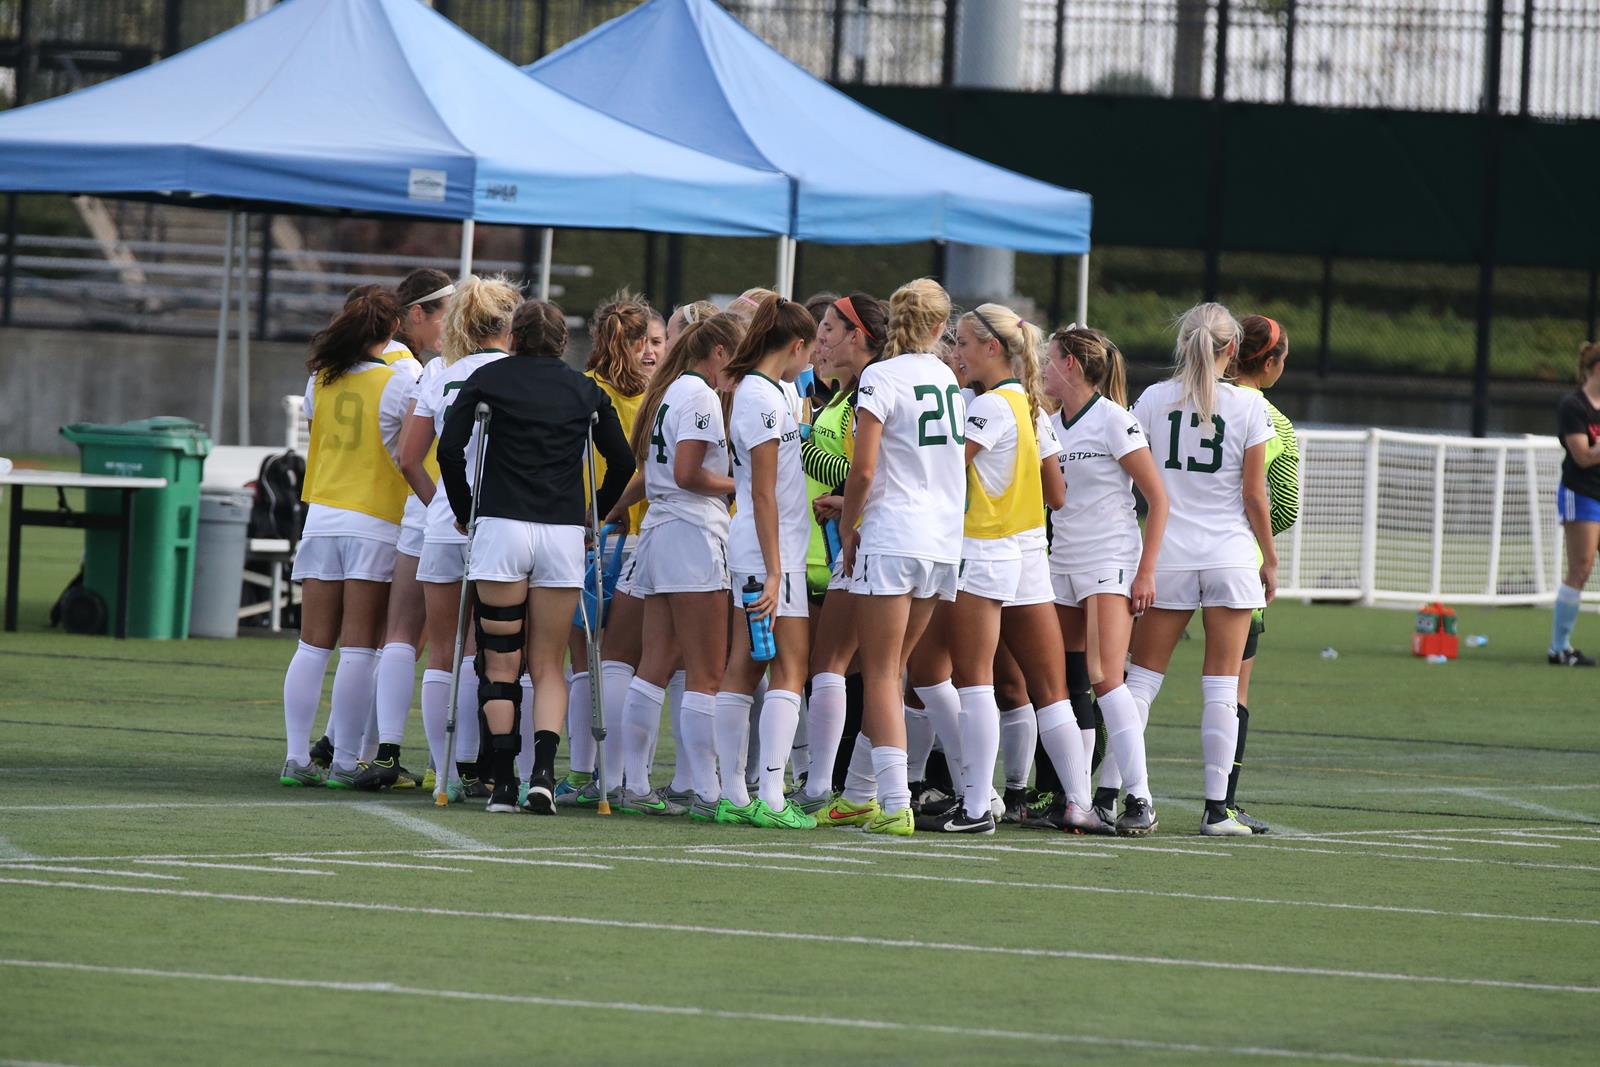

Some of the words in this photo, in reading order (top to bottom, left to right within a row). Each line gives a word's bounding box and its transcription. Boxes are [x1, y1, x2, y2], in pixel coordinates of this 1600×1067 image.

[335, 391, 365, 451] 9
[913, 384, 966, 448] 20
[1165, 410, 1226, 474] 13
